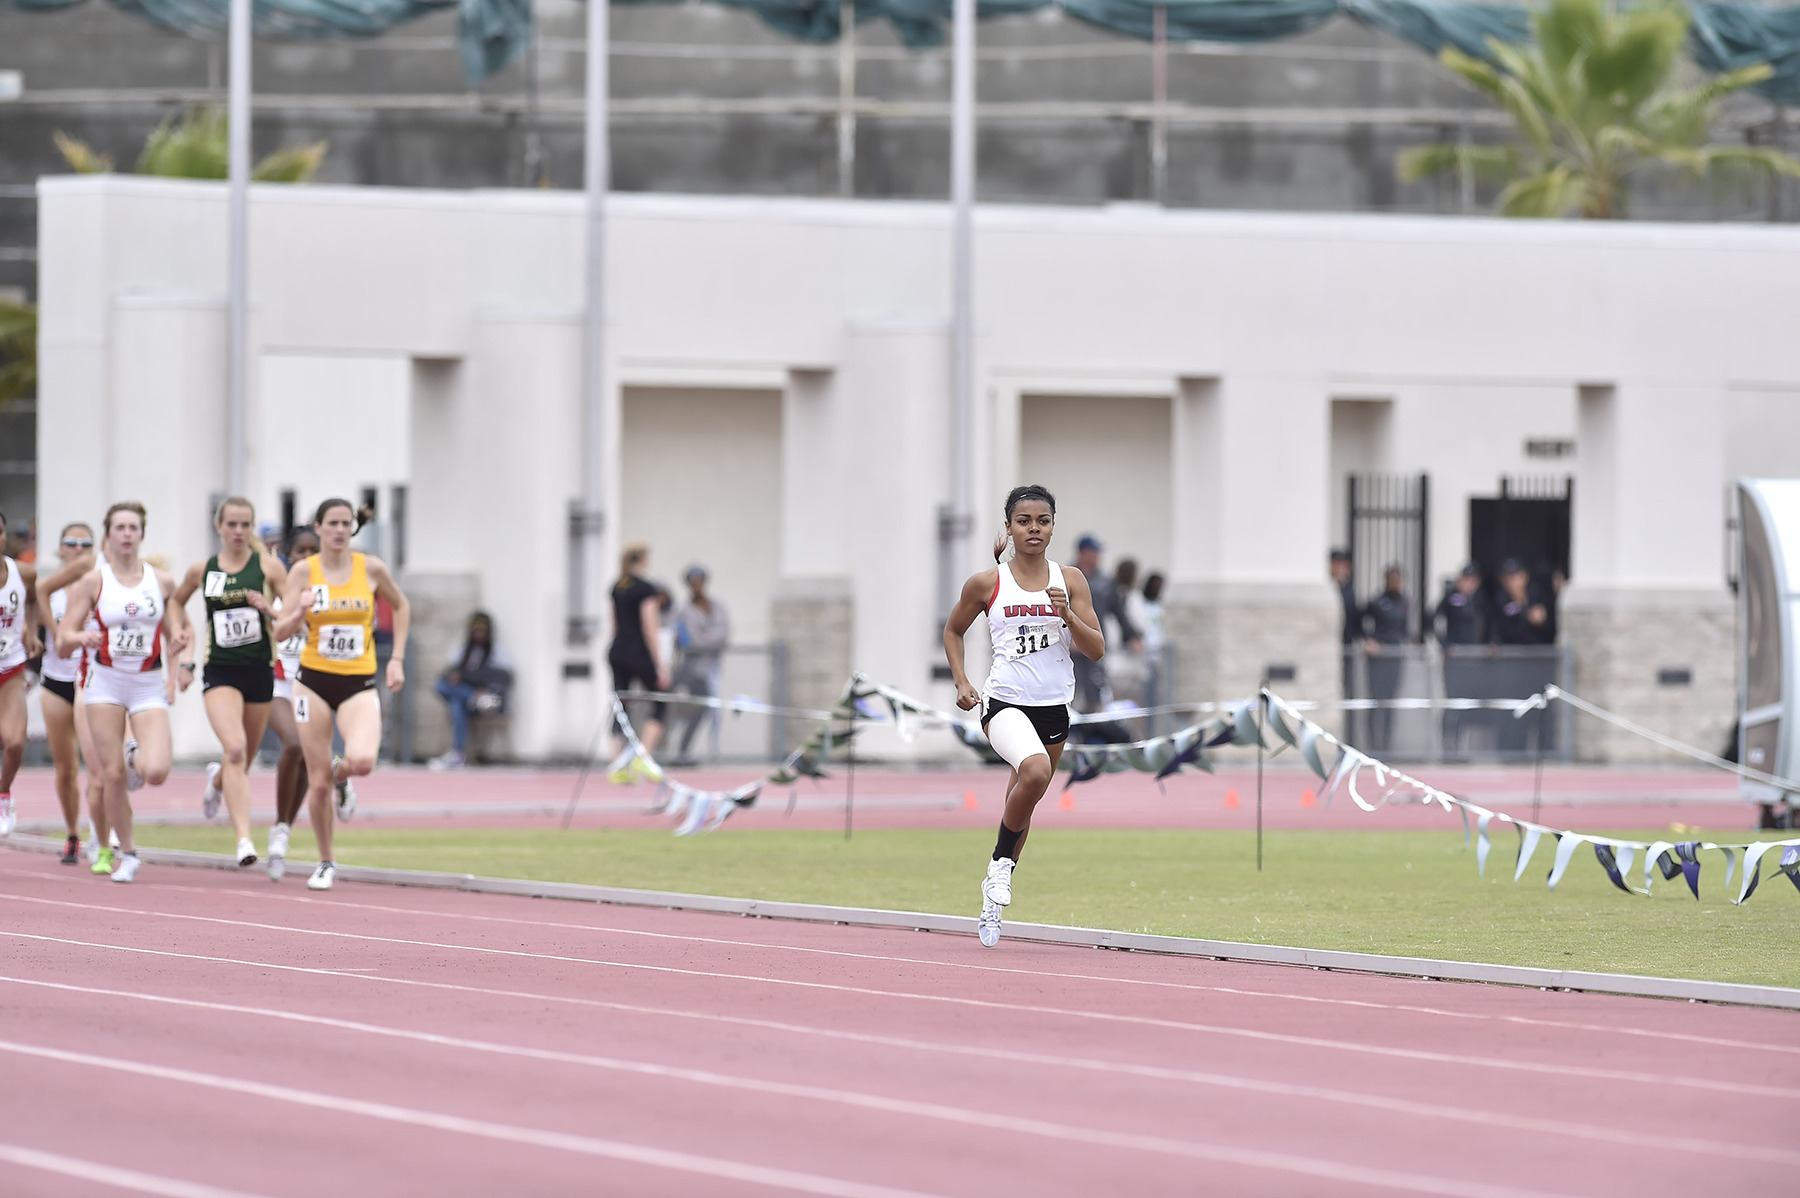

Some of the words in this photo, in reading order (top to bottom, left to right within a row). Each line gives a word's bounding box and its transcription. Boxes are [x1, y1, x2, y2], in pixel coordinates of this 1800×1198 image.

[209, 575, 221, 596] 7
[9, 590, 19, 614] 9
[145, 596, 158, 617] 3
[225, 620, 250, 638] 107
[116, 633, 145, 649] 278
[328, 636, 355, 652] 404
[1015, 634, 1051, 654] 314
[297, 699, 306, 718] 4
